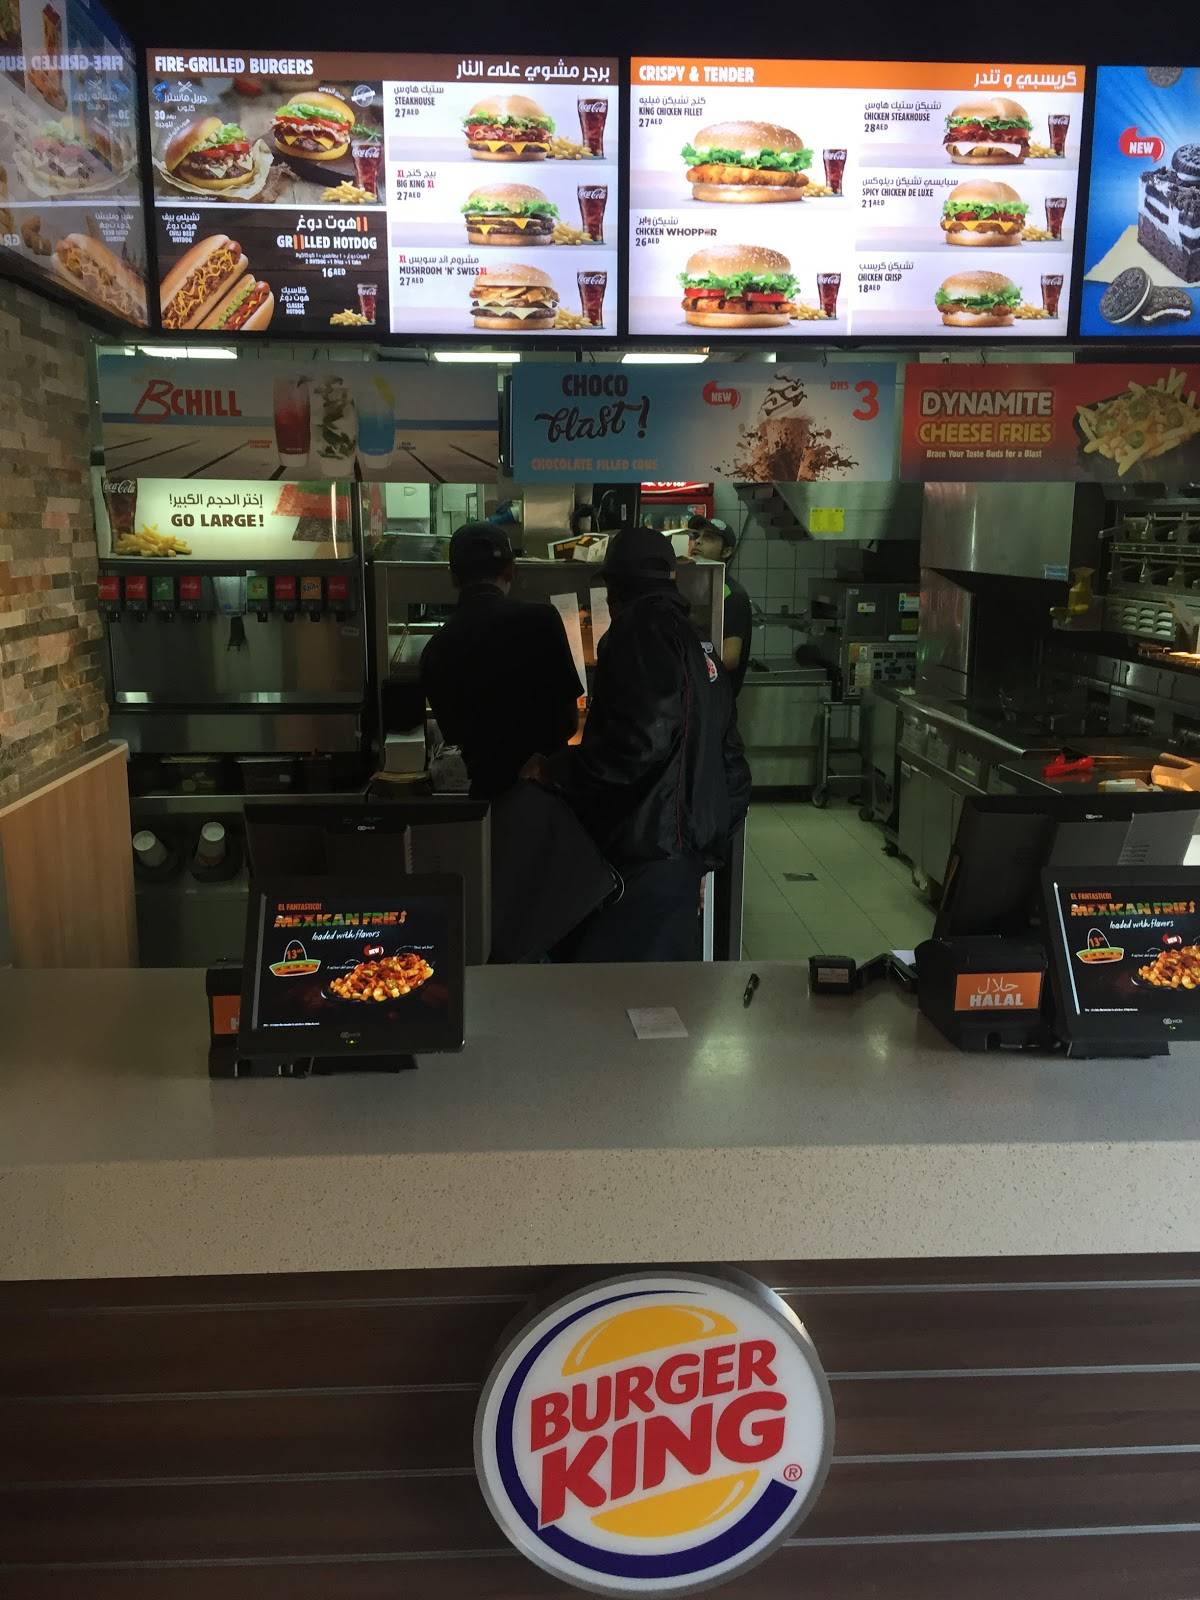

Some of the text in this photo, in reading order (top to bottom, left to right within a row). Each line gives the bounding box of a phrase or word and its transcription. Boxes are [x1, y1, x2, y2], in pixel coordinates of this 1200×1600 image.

[155, 56, 314, 75] FIRE-GRILLED BURGERS
[456, 59, 610, 82] برجر مشوي على النار
[639, 65, 755, 83] CRISPY & TENDER
[974, 68, 1077, 90] كريسبي و تندر
[394, 97, 435, 106] STEAKHOUSE
[154, 110, 165, 120] 30
[639, 106, 703, 116] KING CHICKEN FILLET
[864, 112, 930, 121] CHICKEN STEAKHOUSE
[1129, 141, 1154, 155] NEW
[396, 180, 435, 188] BIG KING XL
[862, 188, 933, 197] SPICY CHICKEN DE LUXE
[635, 227, 664, 236] CHICKEN
[333, 236, 378, 250] HOTDOG
[399, 266, 442, 275] MUSHROOM
[456, 267, 479, 275] SWISS
[857, 273, 902, 282] CHICKEN CRISP
[561, 374, 629, 397] CHOCO
[711, 392, 732, 403] NEW
[852, 379, 880, 421] 3
[921, 390, 1053, 417] DYNAMITE
[919, 423, 1051, 443] CHEESE FRIES
[926, 450, 946, 459] Brace
[948, 450, 964, 459] Your
[966, 450, 984, 458] Taste
[531, 458, 593, 471] CHOCOLATE
[596, 459, 629, 471] FILLED
[206, 494, 240, 507] الحجم
[242, 494, 263, 509] إختر
[171, 513, 194, 527] GO
[278, 903, 285, 911] EL
[1071, 903, 1152, 917] MEXICAN
[274, 913, 360, 928] MEXICAN
[1110, 920, 1131, 929] loaded
[311, 929, 381, 941] loaded with flavors
[977, 977, 1019, 995] حلال
[969, 993, 1023, 1007] HALAL
[531, 1339, 778, 1452] BURGER
[541, 1391, 788, 1526] KING
